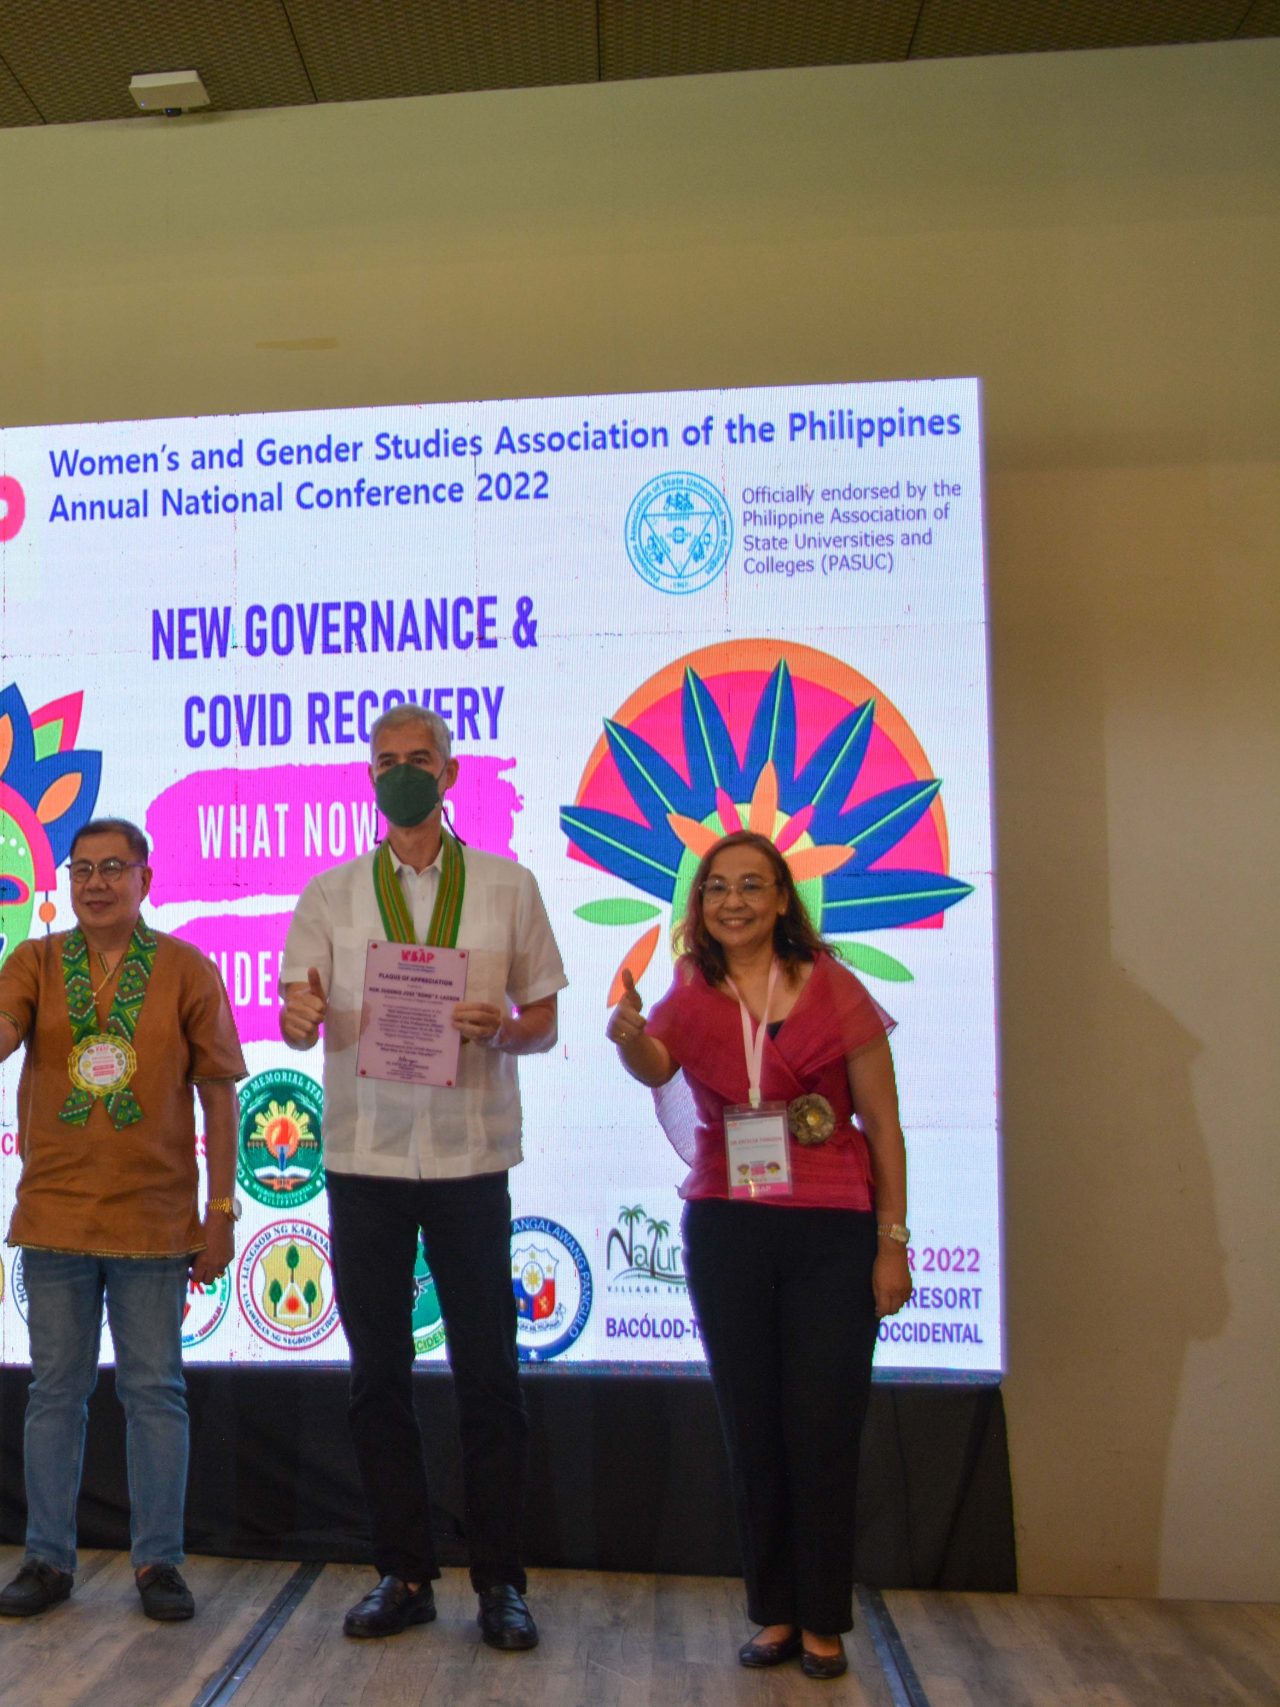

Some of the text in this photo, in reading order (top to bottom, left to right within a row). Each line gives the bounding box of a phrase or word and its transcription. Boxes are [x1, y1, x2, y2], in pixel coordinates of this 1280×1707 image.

[49, 408, 962, 479] Women's and Gender Studies Association of the Philippines
[49, 471, 550, 523] Annual National Conference 2022
[742, 479, 962, 507] Officially endorsed by the
[742, 502, 951, 529] Philippine Association of
[743, 528, 933, 552] State Universities and
[743, 553, 895, 578] Colleges (PASUC)
[152, 595, 539, 660] NEW GOVERNANCE &
[184, 686, 505, 748] COVID RECERY
[197, 803, 293, 860] WHAT
[250, 1071, 304, 1091] MEMORIAL
[922, 1246, 980, 1272] 2022
[607, 1285, 658, 1294] VILLAGE
[906, 1287, 982, 1309] RESORT
[569, 1271, 592, 1338] PANGULO
[878, 1321, 983, 1344] OCCIDENTAL
